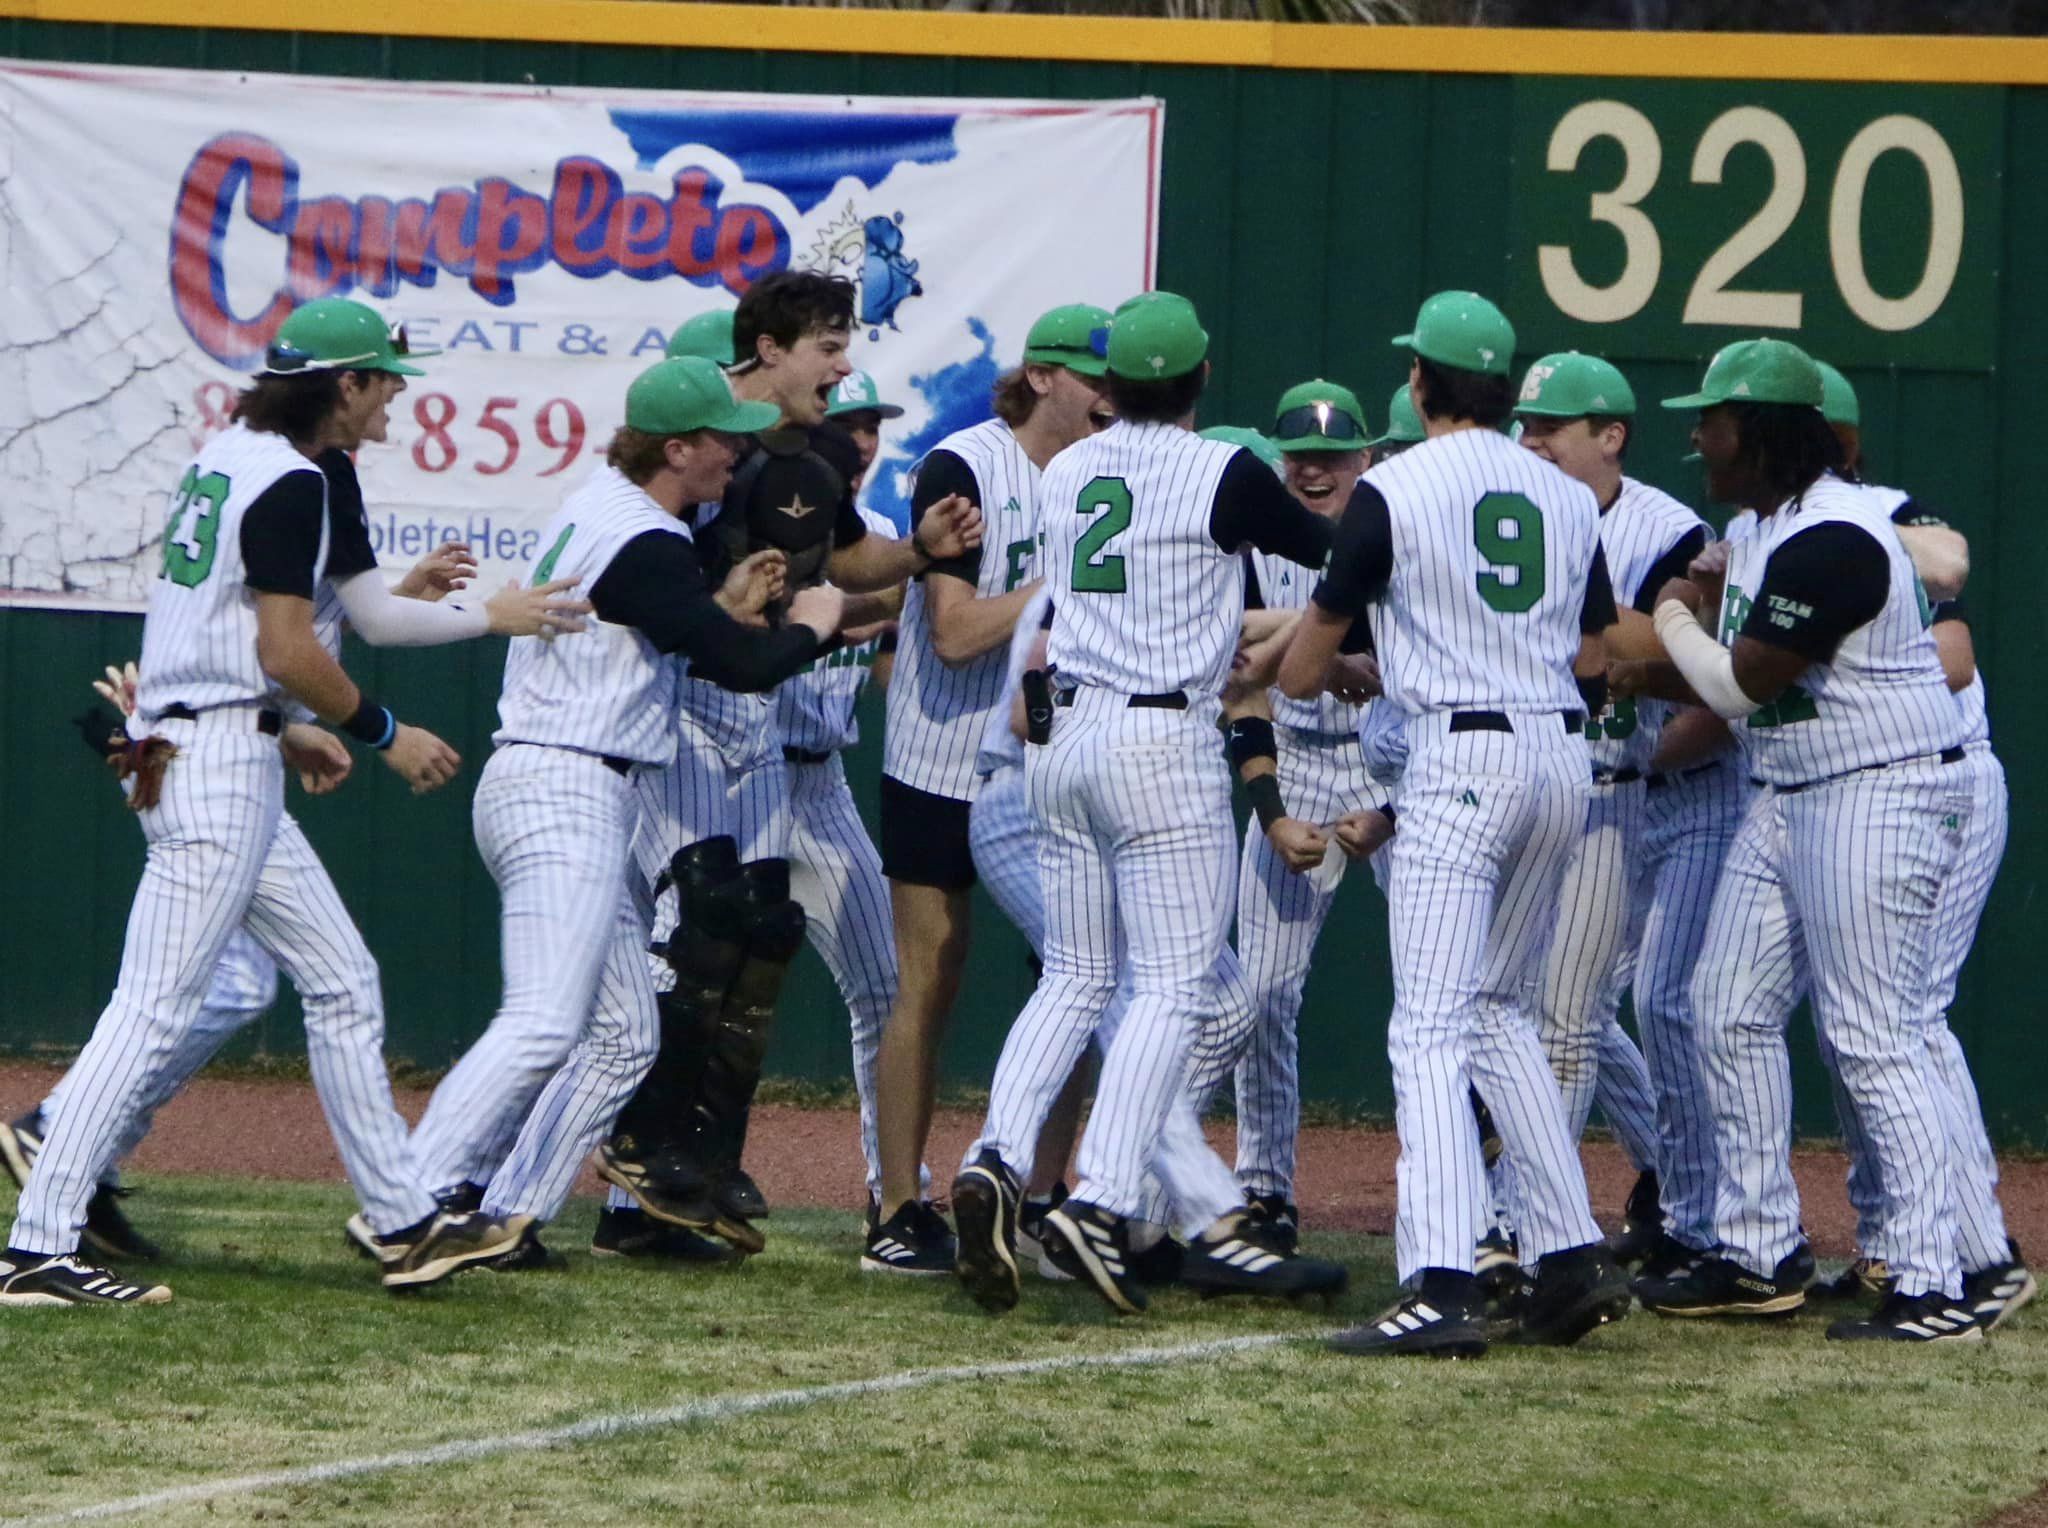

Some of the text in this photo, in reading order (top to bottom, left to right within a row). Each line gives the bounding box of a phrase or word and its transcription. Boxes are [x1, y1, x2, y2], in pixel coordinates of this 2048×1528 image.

[171, 131, 791, 371] Complete
[1537, 99, 1964, 332] 320
[402, 318, 668, 357] EAT & A
[411, 391, 609, 478] 859-
[368, 512, 540, 561] pleteHea
[1071, 475, 1134, 593] 2
[1474, 490, 1546, 614] 9
[1767, 594, 1813, 618] TEAM
